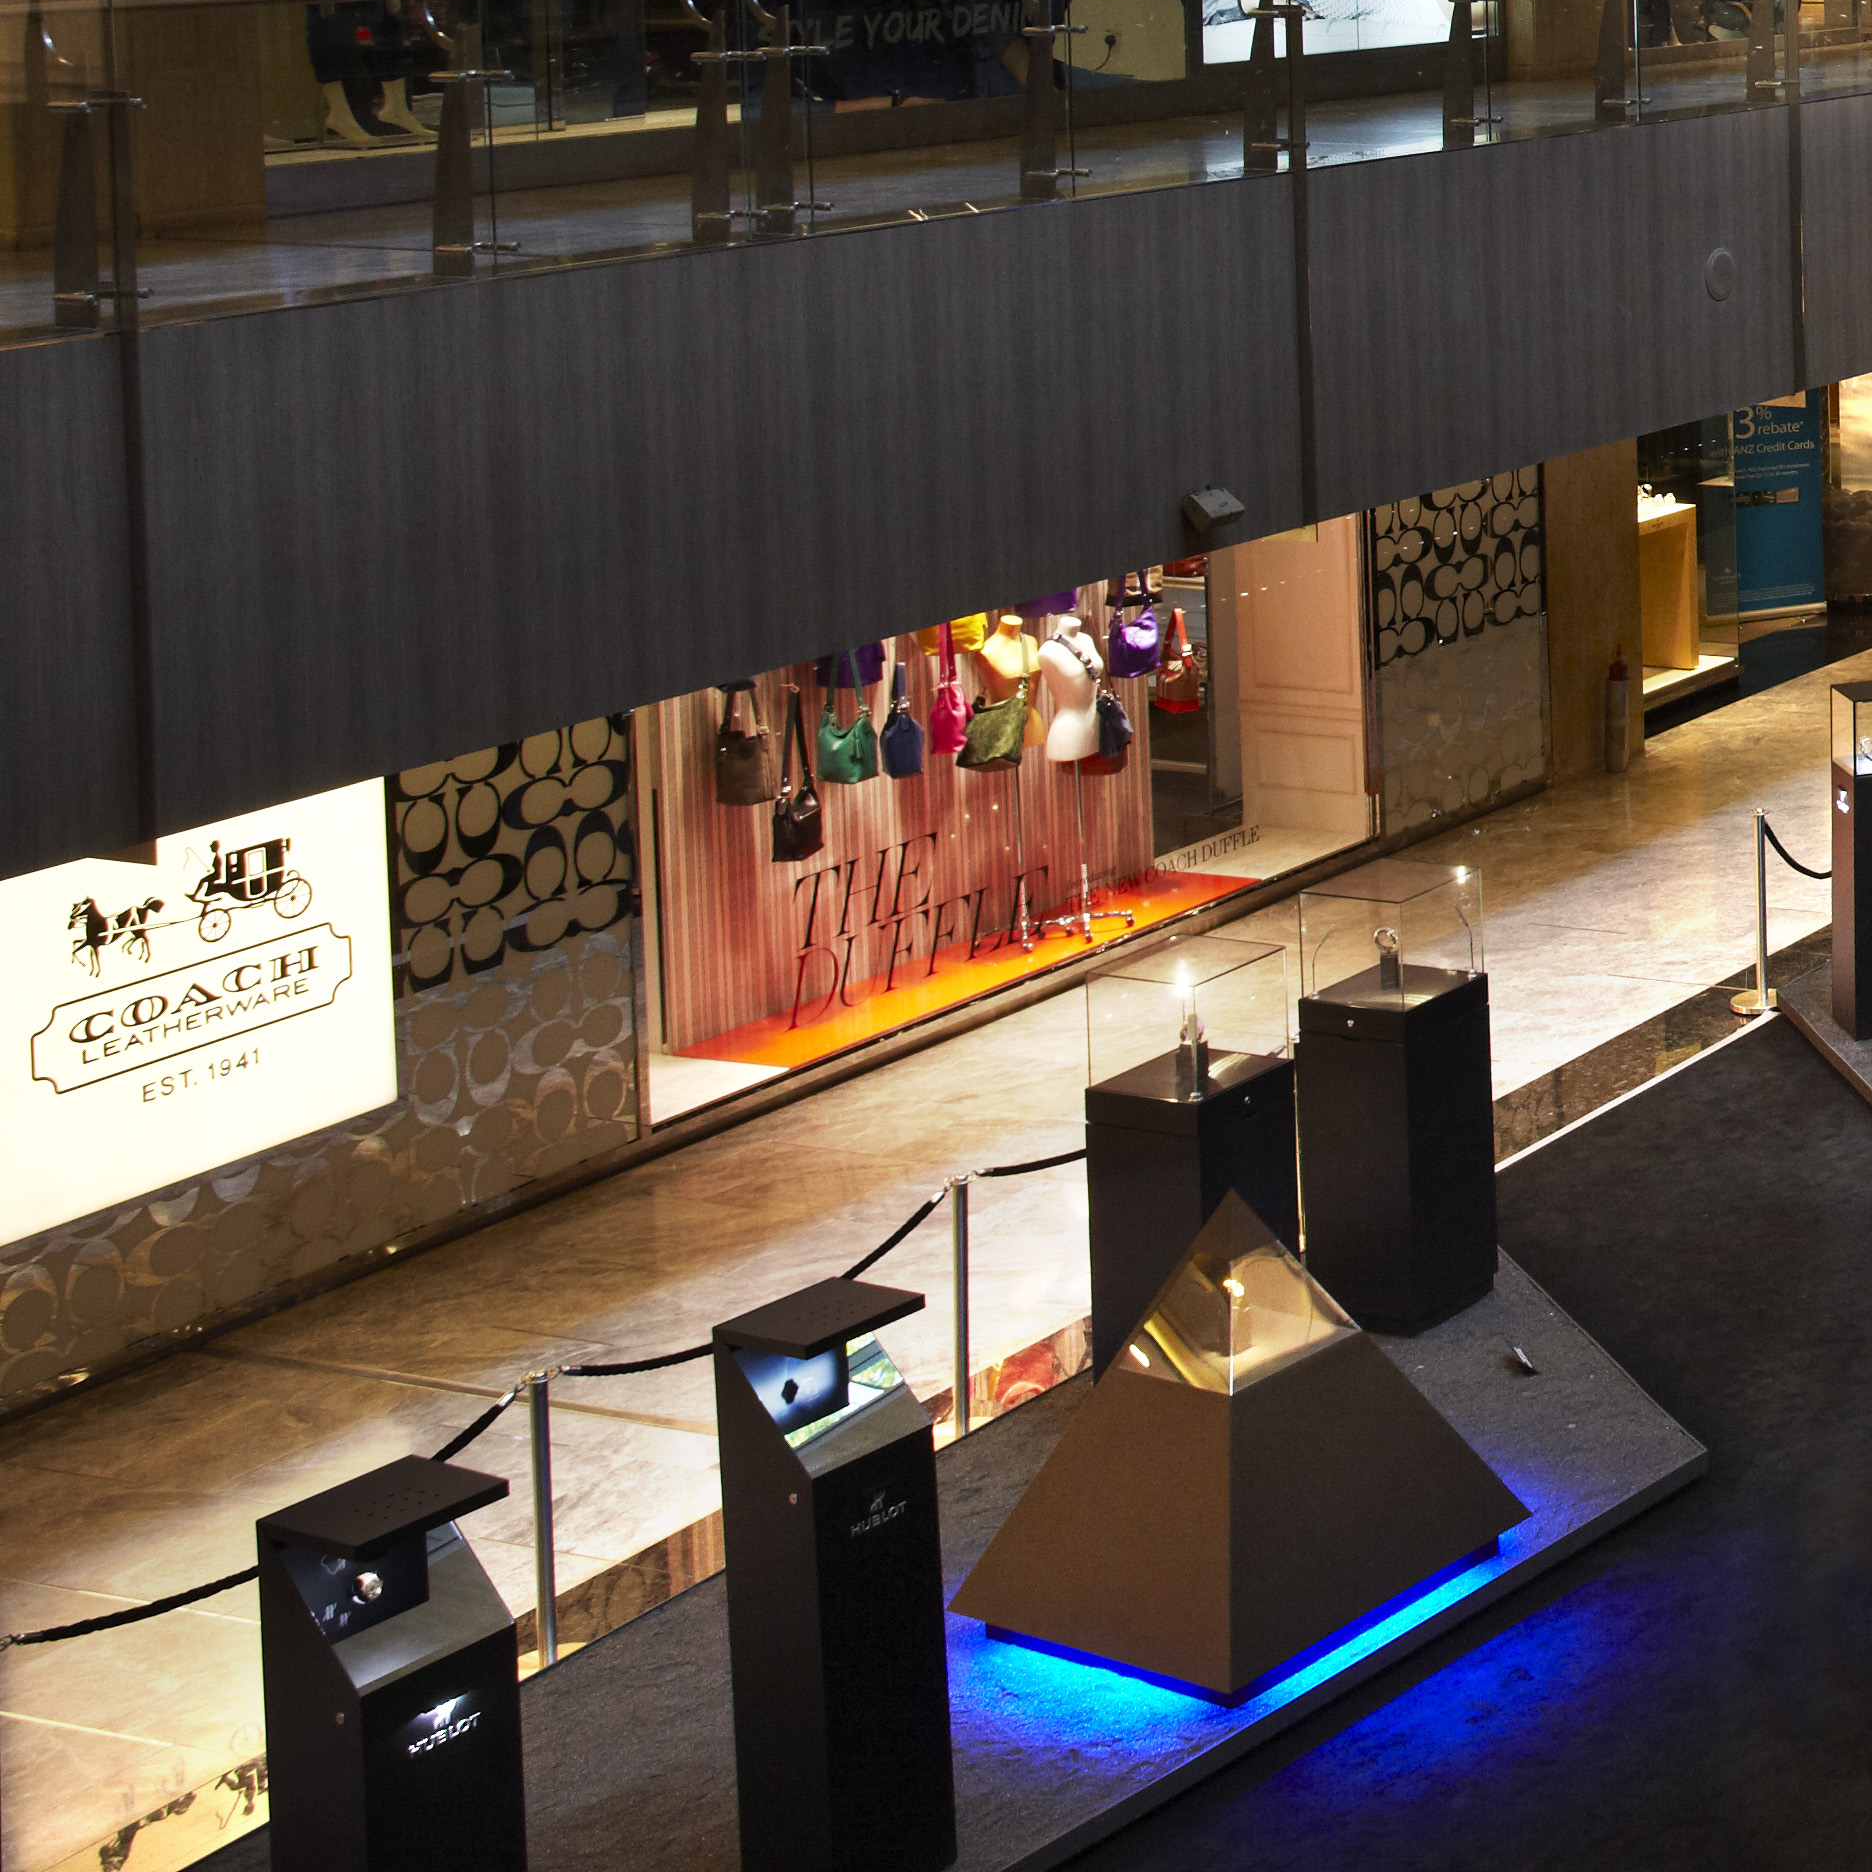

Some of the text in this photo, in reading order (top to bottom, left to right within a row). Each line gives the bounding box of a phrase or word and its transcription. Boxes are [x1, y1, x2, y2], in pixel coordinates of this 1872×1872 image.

[864, 8, 946, 49] YOUR
[1734, 444, 1754, 455] ANZ
[1756, 442, 1785, 454] Credit
[1788, 439, 1815, 451] Cards
[1144, 847, 1198, 884] COACH
[1202, 824, 1261, 863] DUFFLE
[792, 832, 938, 952] THE
[783, 865, 1049, 1031] DUFFLE
[69, 945, 320, 1043] COACH
[82, 977, 310, 1064] LEATHERWARE
[142, 1047, 261, 1103] EST. 1941
